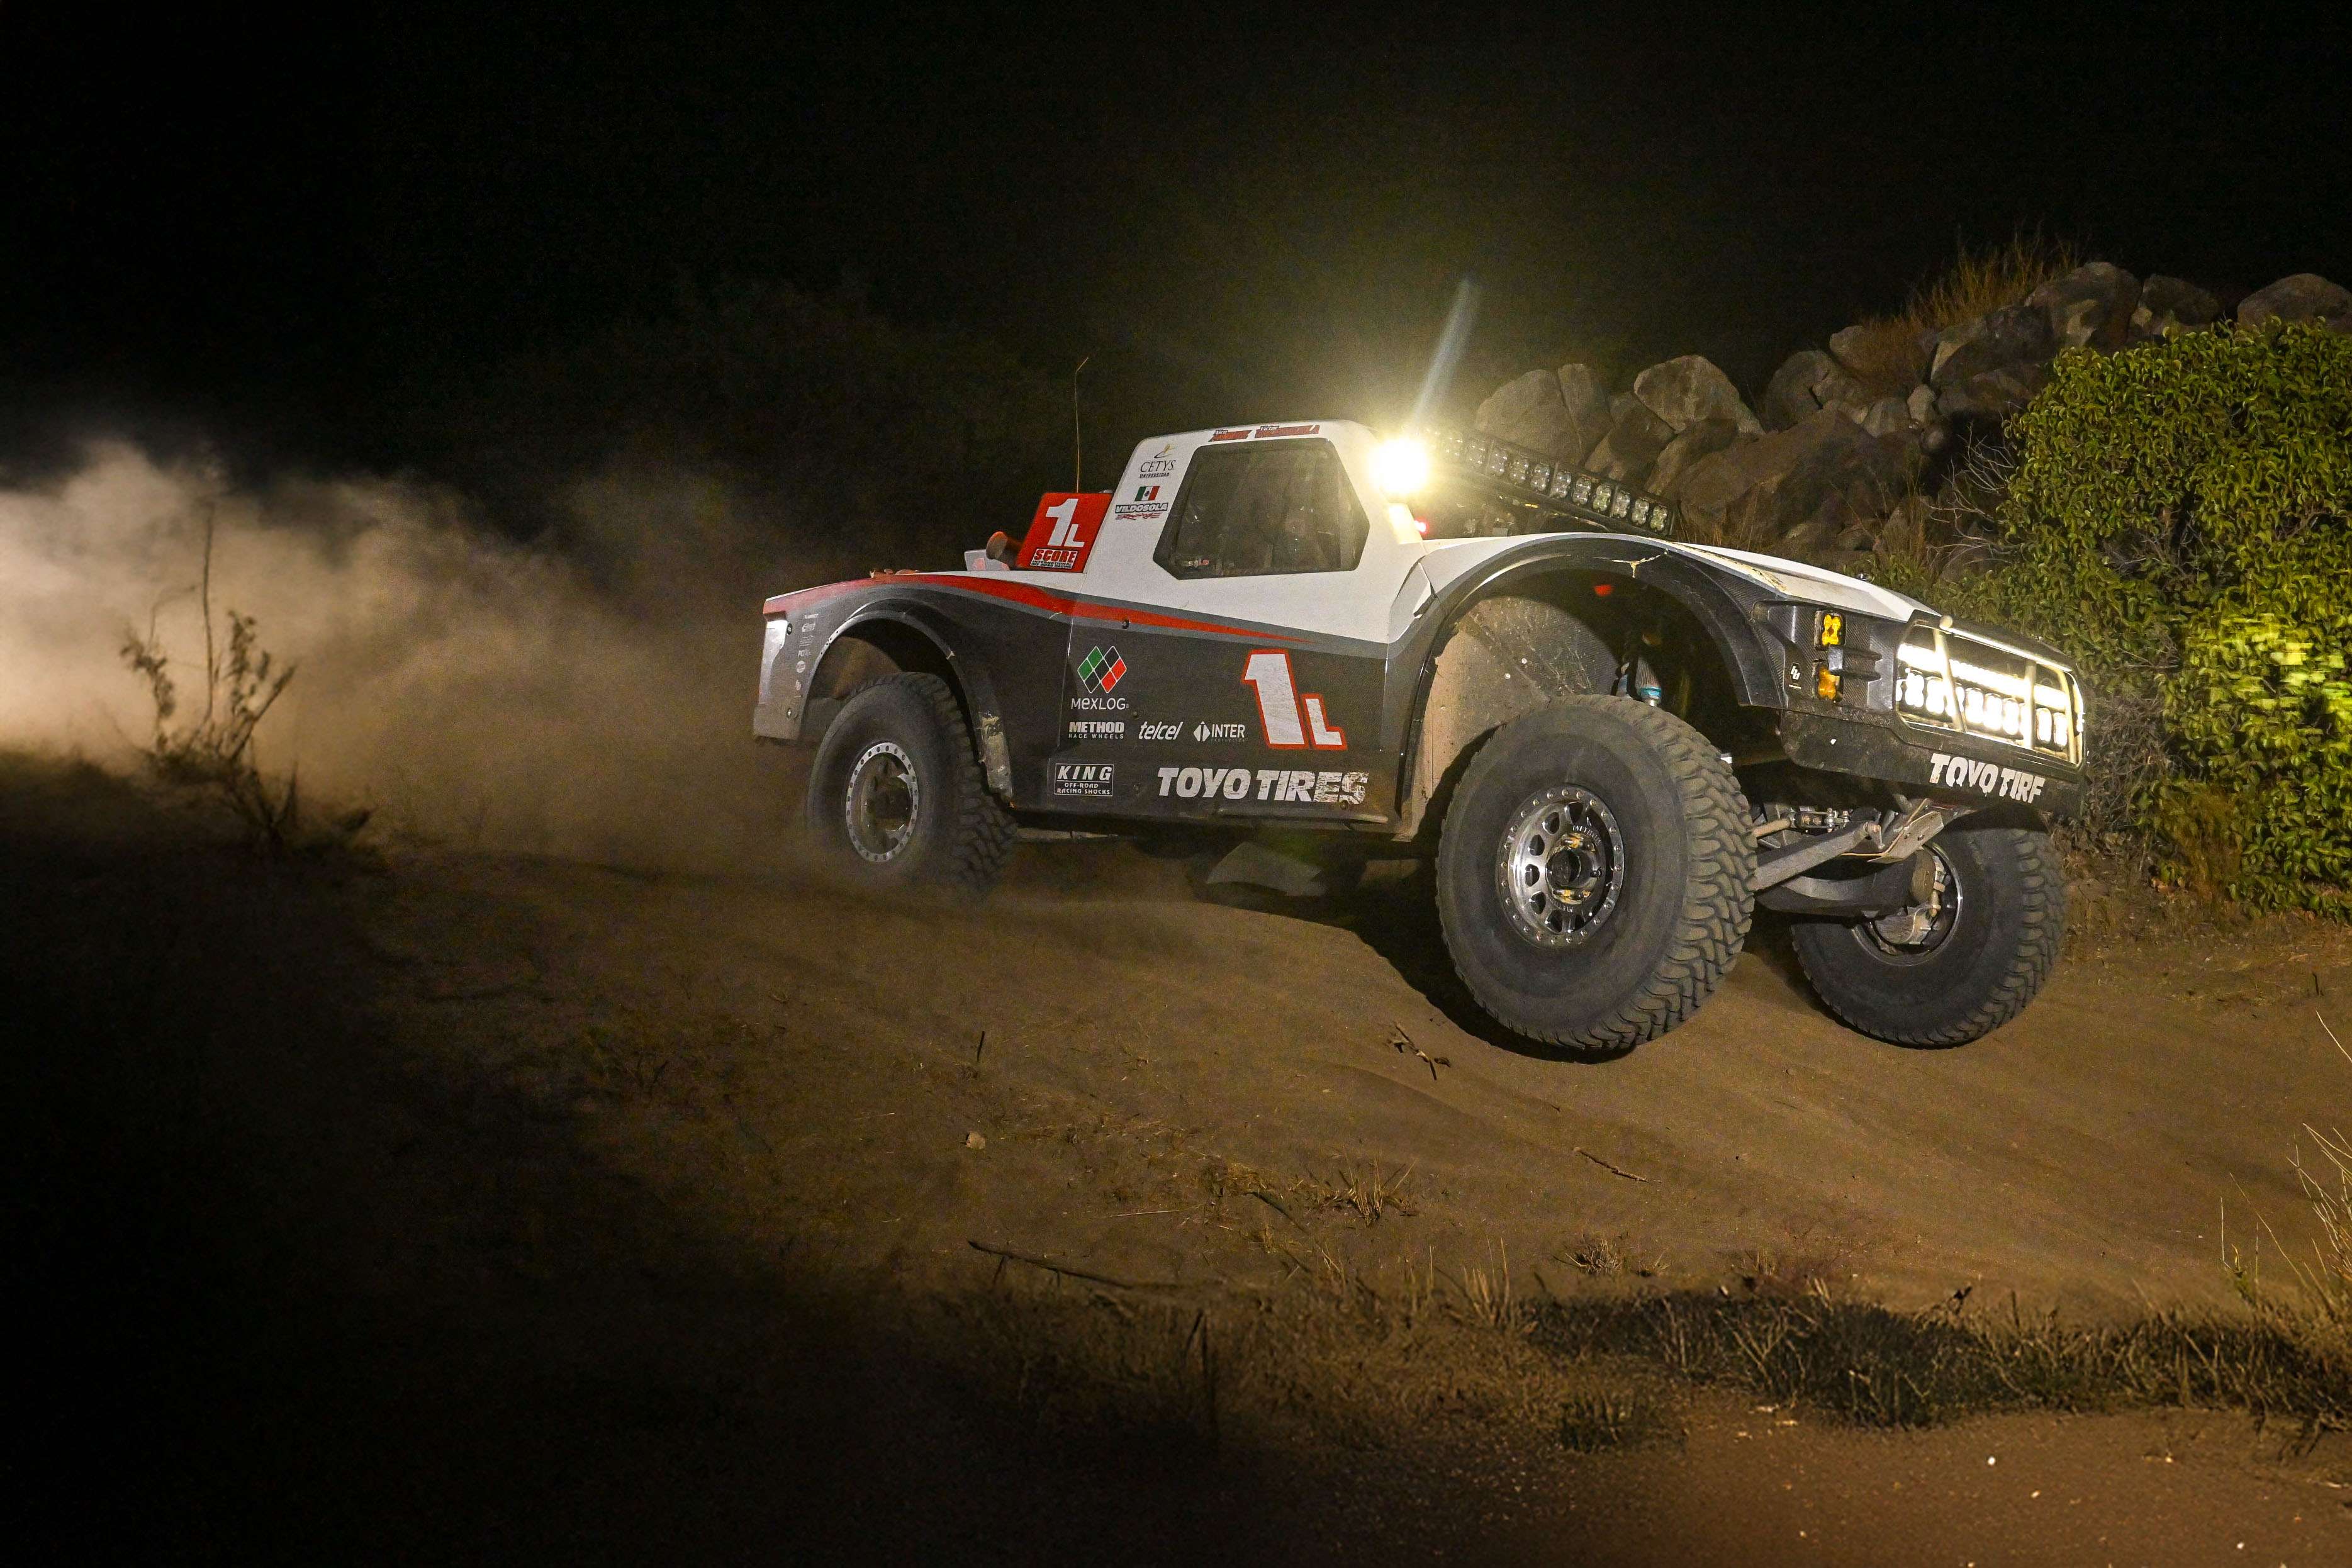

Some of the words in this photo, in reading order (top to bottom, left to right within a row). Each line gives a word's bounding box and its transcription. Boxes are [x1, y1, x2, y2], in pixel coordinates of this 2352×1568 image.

[1140, 460, 1176, 473] CETYS
[1115, 503, 1168, 513] VILDOSOLA
[1034, 549, 1077, 563] SCORE
[1069, 721, 1124, 733] METHOD
[1138, 721, 1184, 740] telcel
[1211, 724, 1245, 738] INTER
[1058, 766, 1112, 781] KING
[1158, 767, 1252, 800] TOYO
[1256, 770, 1369, 805] TIRES
